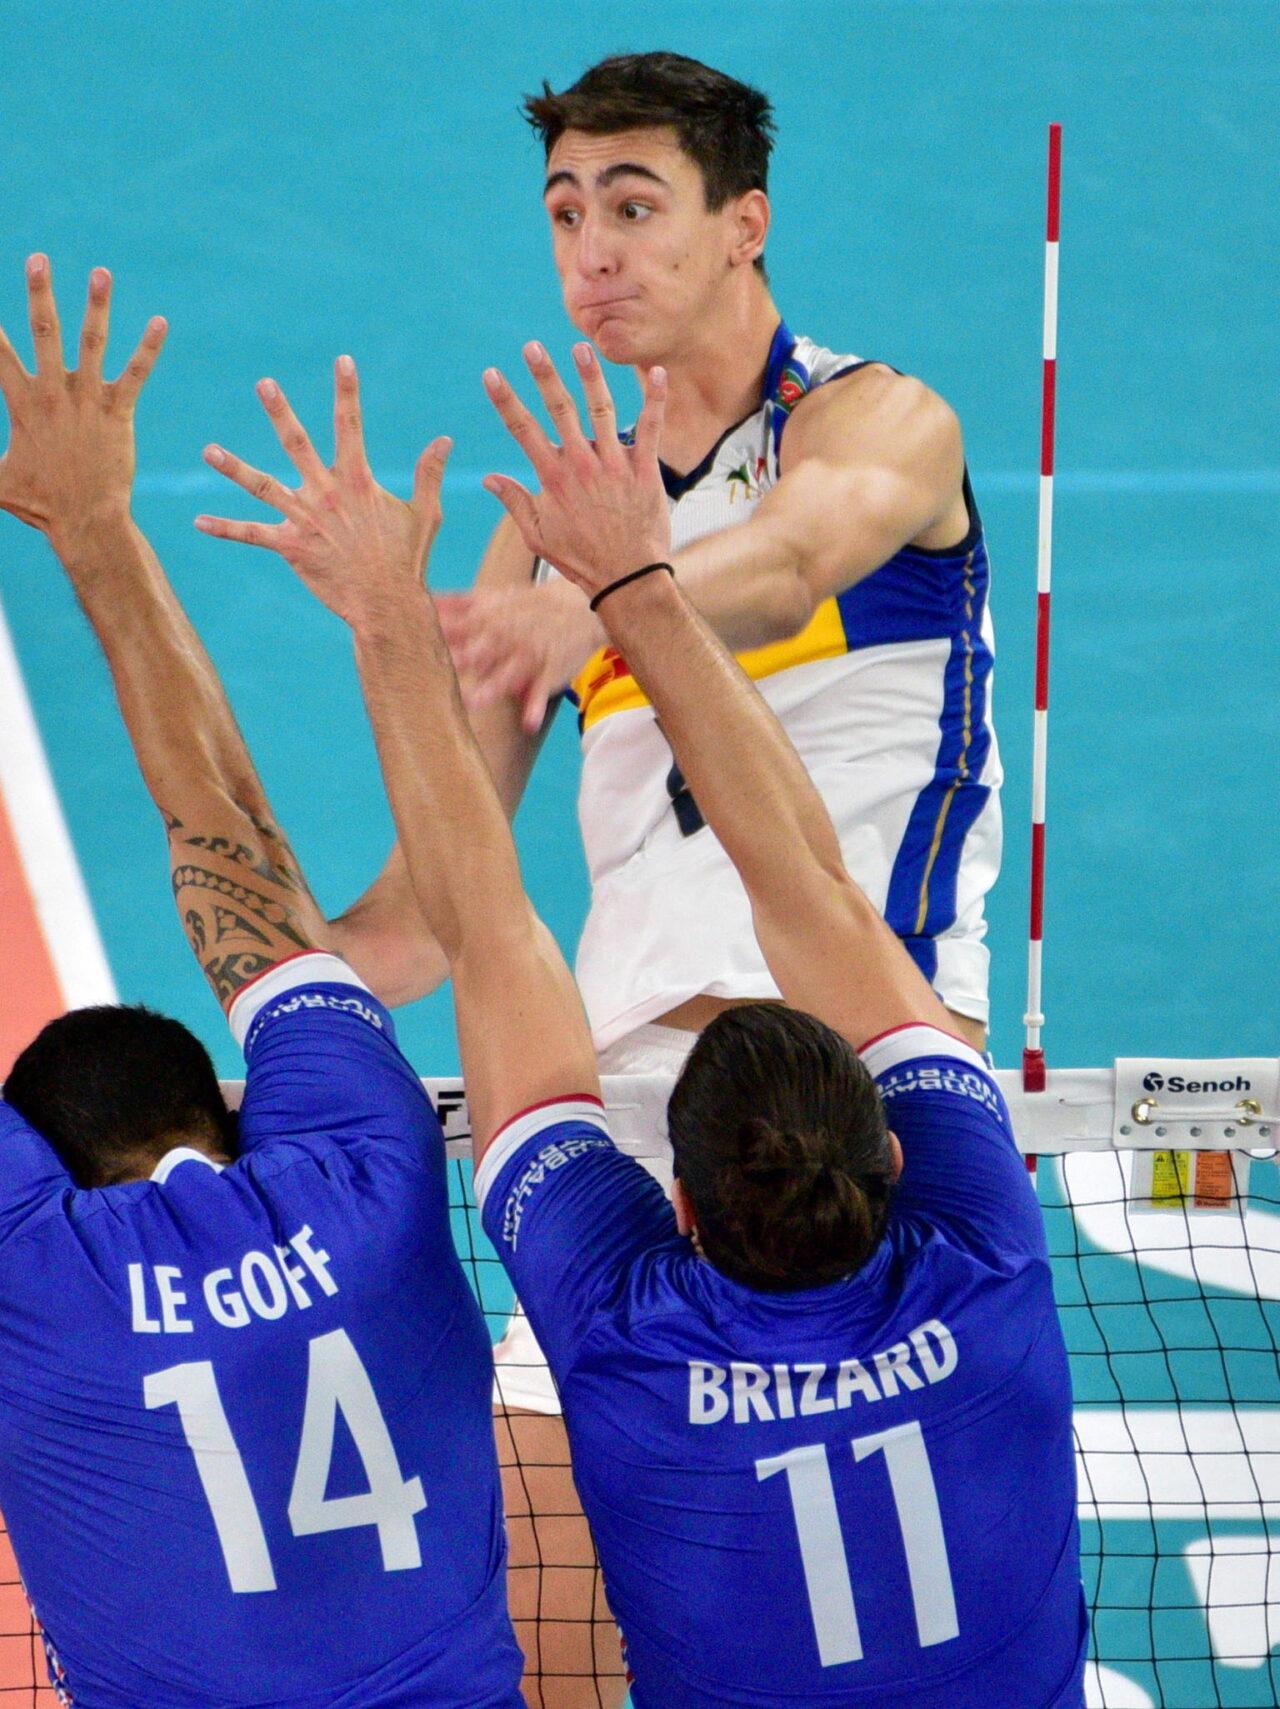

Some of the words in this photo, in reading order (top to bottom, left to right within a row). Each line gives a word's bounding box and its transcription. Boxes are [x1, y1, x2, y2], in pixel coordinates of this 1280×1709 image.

[1167, 1075, 1251, 1093] Senoh
[128, 1263, 194, 1333] LE
[203, 1224, 339, 1328] GOFF
[688, 1319, 958, 1425] BRIZARD
[143, 1327, 428, 1594] 14
[755, 1420, 960, 1667] 11
